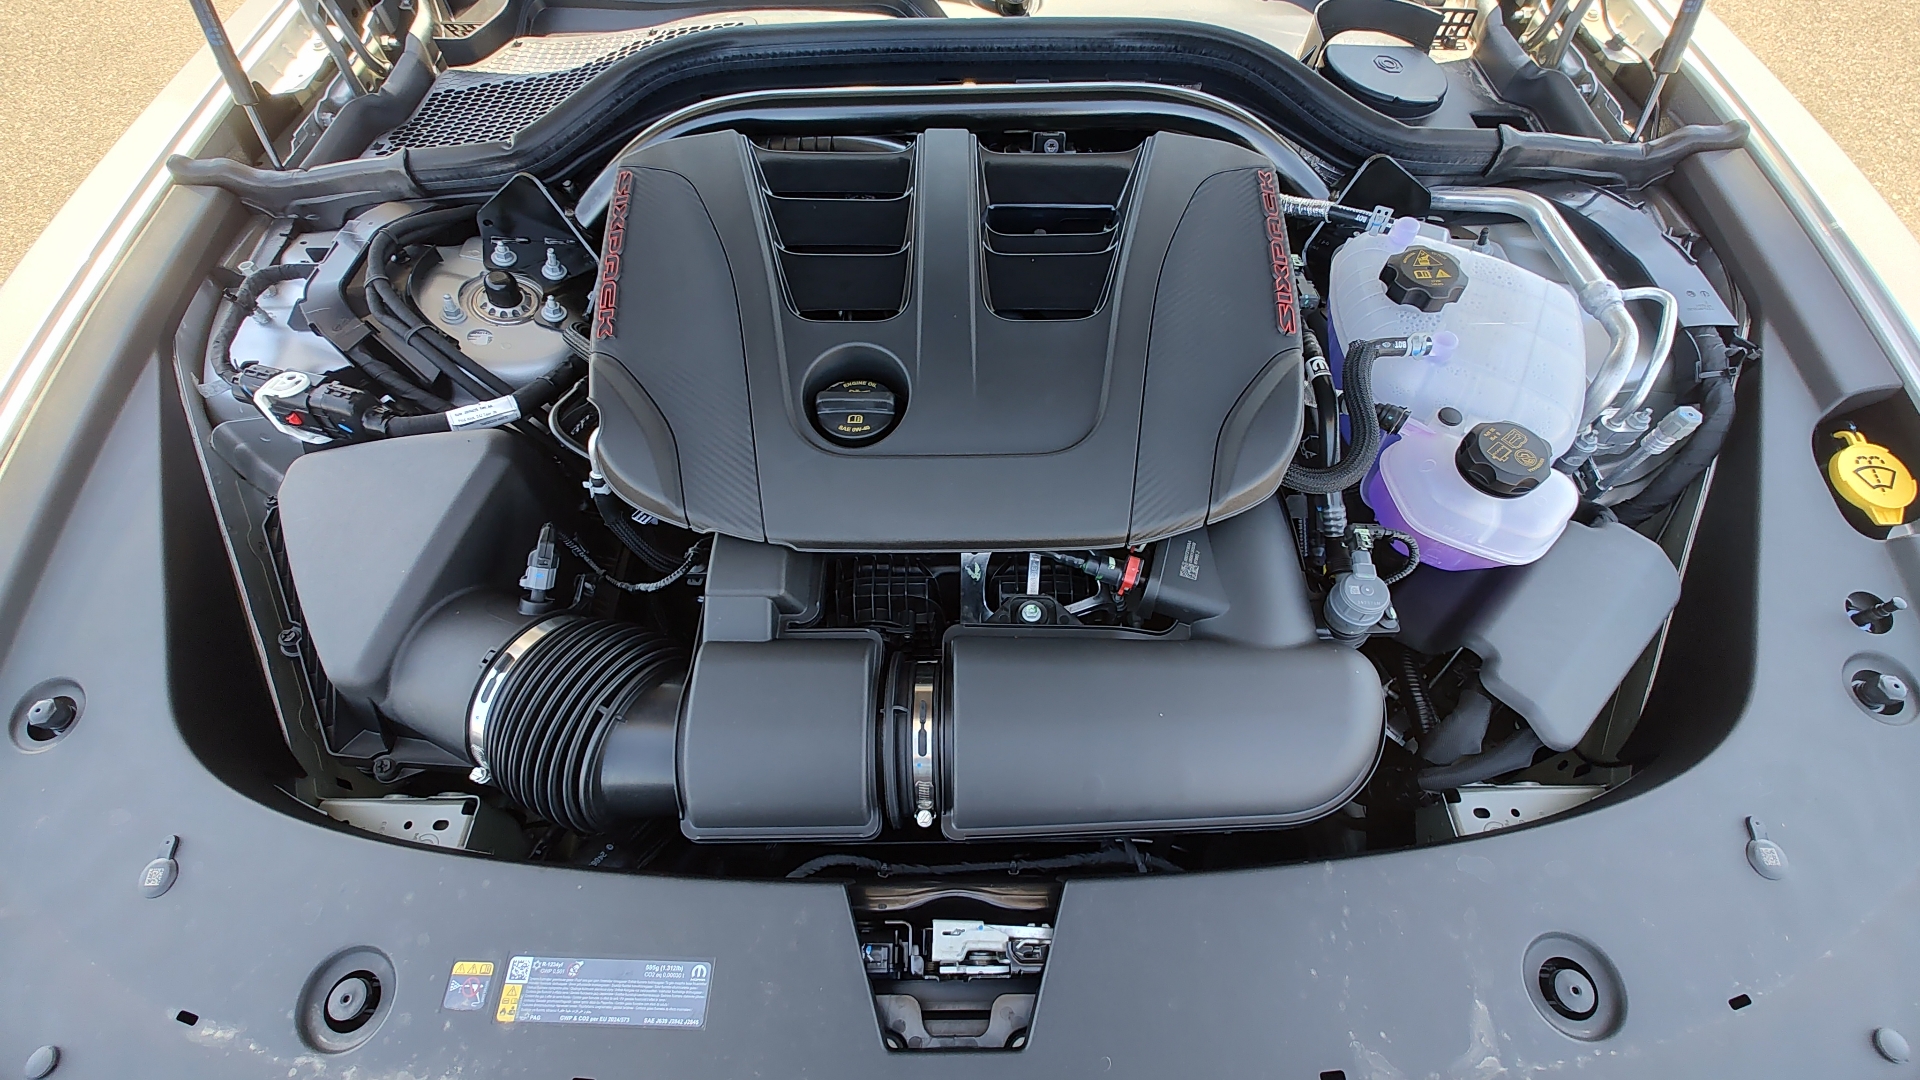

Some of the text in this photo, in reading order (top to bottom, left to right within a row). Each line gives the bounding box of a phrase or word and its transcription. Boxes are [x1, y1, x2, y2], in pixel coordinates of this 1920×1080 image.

[597, 170, 634, 339] SIXPACK
[1258, 170, 1296, 334] SIXPACK
[838, 424, 851, 432] SAE
